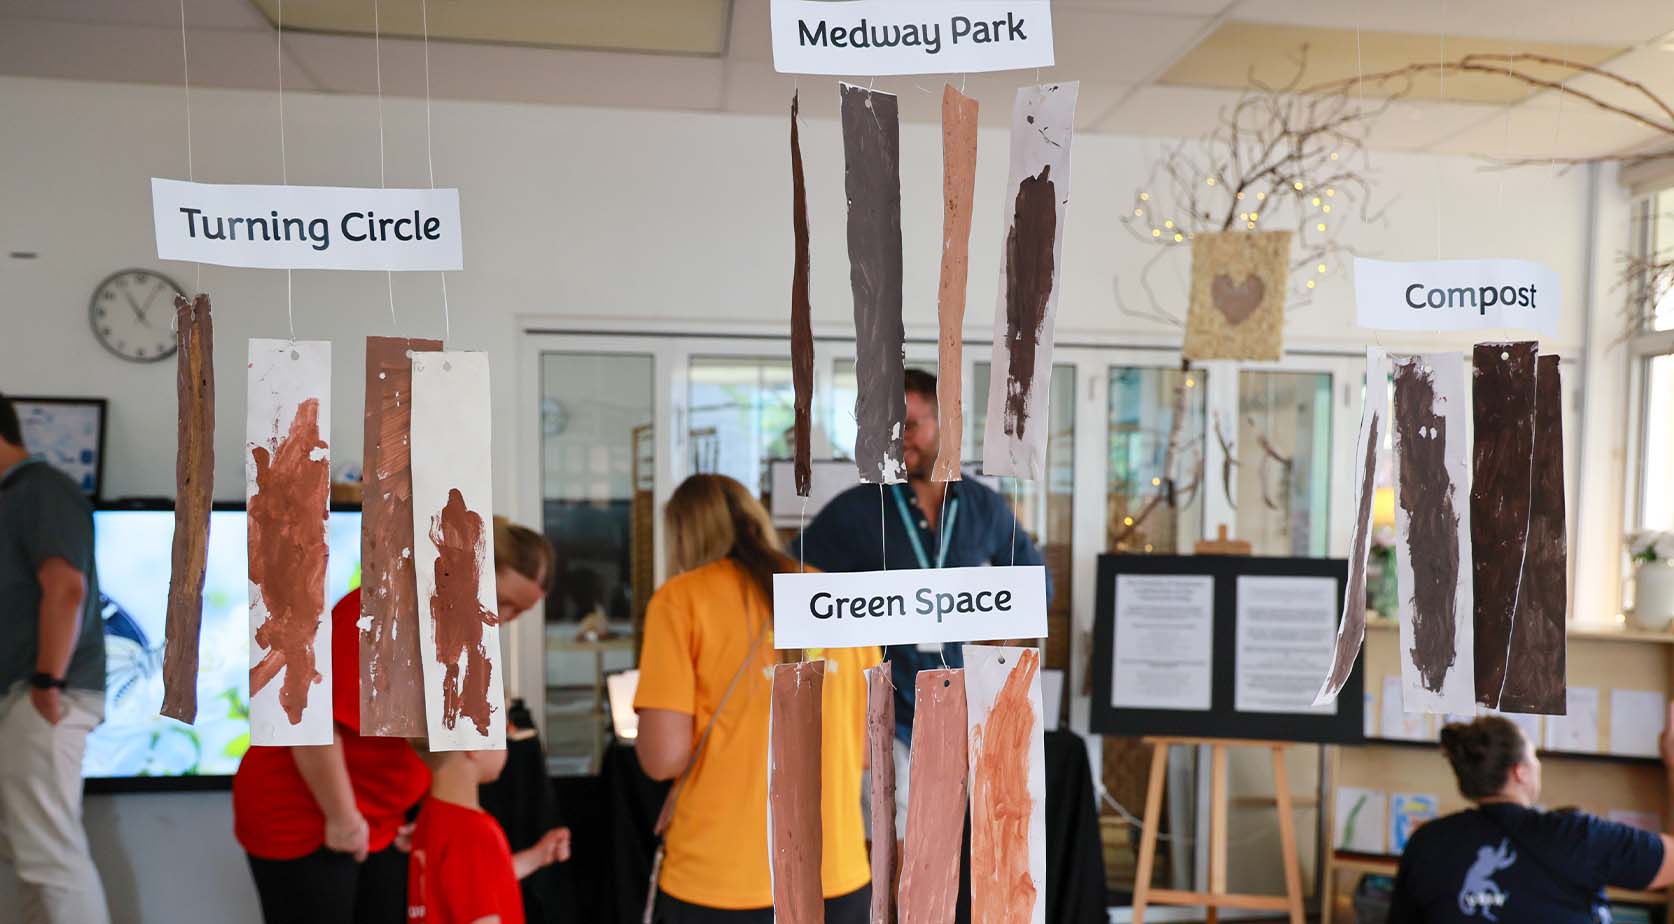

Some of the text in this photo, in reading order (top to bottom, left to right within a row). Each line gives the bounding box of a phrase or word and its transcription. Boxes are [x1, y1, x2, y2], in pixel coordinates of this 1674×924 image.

[798, 12, 1028, 54] Medway Park
[179, 207, 441, 251] Turning Circle
[1405, 283, 1537, 315] Compost
[809, 588, 1012, 623] Green Space
